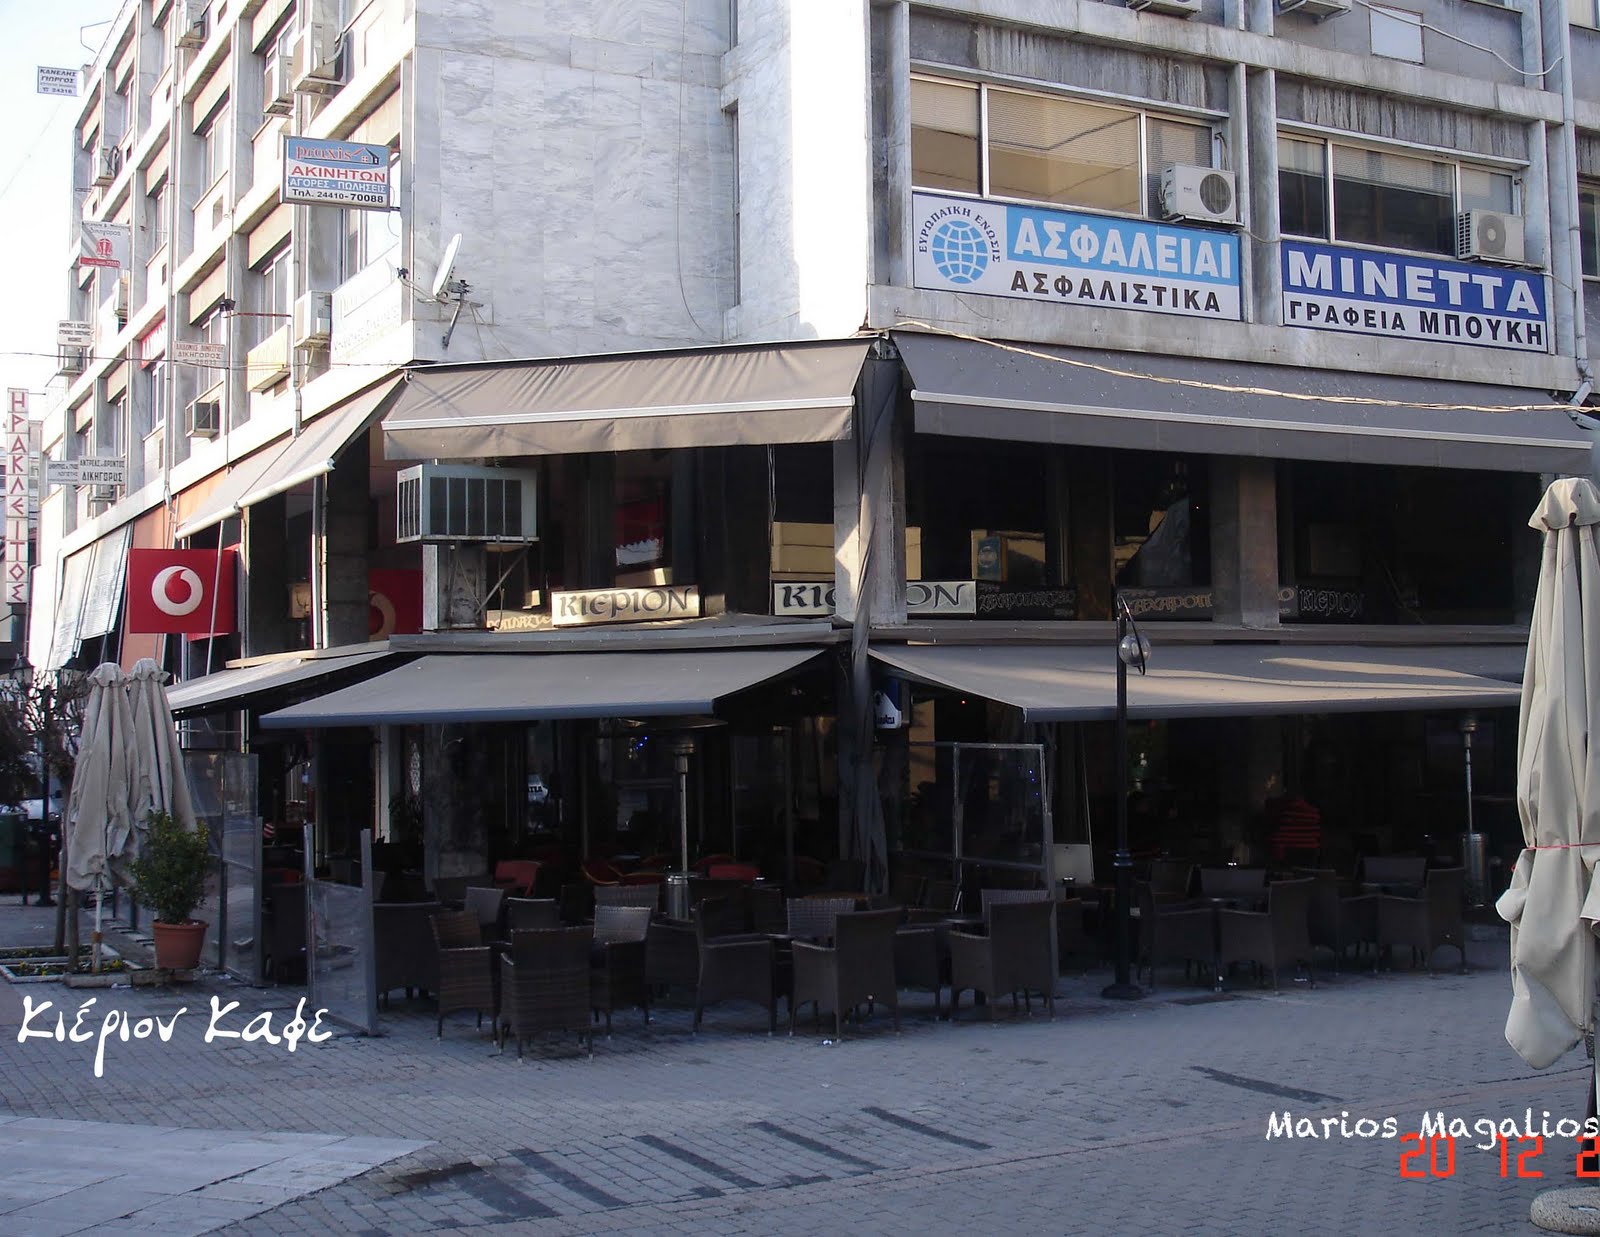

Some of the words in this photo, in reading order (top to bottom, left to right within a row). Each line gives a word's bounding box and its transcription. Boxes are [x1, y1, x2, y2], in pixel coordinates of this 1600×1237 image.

[291, 166, 386, 183] ΑΚΙΝΗΤΩΝ
[296, 147, 351, 160] praxis
[290, 178, 329, 188] ΑΓΟΡΕΣ
[338, 181, 386, 193] ΠΩΛΗΣΕΙΣ
[292, 189, 314, 197] Τηλ.
[974, 214, 1001, 263] ΕΝΩΣΙΣ
[1014, 217, 1231, 279] ΑΣΦΑΛΕΙΑΙ
[1010, 270, 1221, 312] ΑΣΦΑΛΙΣΤΙΚΑ
[1288, 250, 1540, 315] ΜΙΝΕΤΤΑ
[1290, 301, 1406, 331] ΓΡΑΦΕΙΑ
[1420, 311, 1542, 346] ΜΠΟΥΚΗ
[10, 391, 27, 602] ΗΡΑΚΛΕΙΤΟΣ
[82, 471, 123, 482] ΔΙΚΗΓΟΡΟΣ
